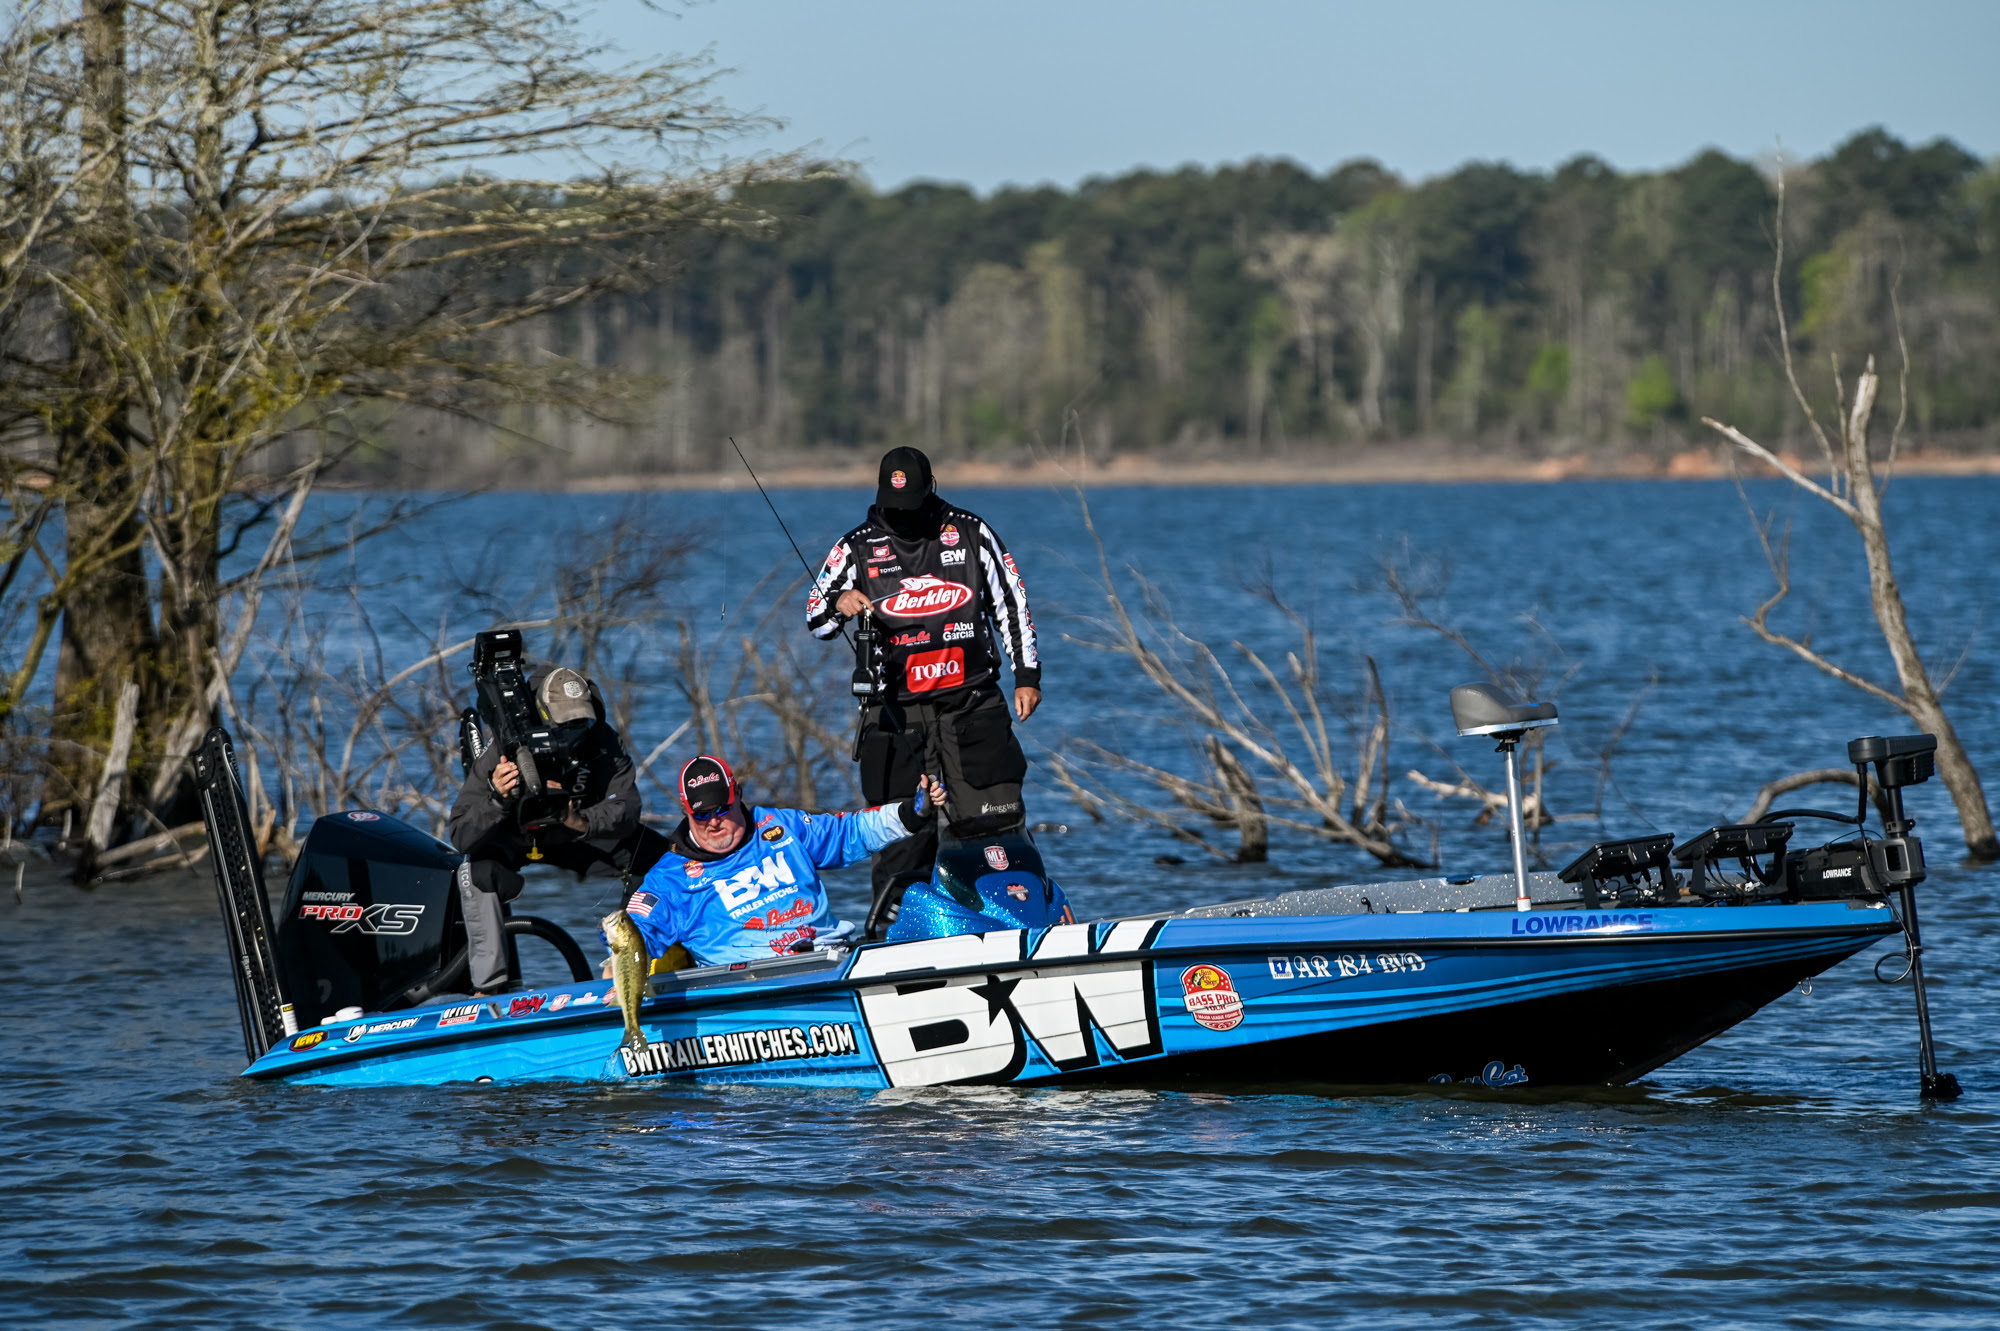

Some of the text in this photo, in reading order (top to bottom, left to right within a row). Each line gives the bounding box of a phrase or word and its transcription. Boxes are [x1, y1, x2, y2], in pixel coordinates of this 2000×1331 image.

[880, 565, 902, 574] TOYOTA
[893, 587, 961, 612] Berkley
[943, 630, 975, 641] Garcia
[953, 622, 974, 632] Abu
[911, 660, 959, 681] TORO
[987, 851, 1005, 862] MLF
[1822, 867, 1852, 879] LOWRANCE
[302, 891, 355, 901] MERCURY
[729, 885, 799, 919] TRAILER HITCHES
[767, 908, 796, 926] Bass
[794, 898, 813, 916] Cat
[1511, 914, 1653, 935] LOWRANCE
[770, 931, 799, 955] Strike
[1276, 962, 1283, 972] 1
[1294, 952, 1425, 978] AR 184 BVD
[1189, 993, 1237, 1007] BASS PRO
[442, 1003, 481, 1020] OPTIMA
[367, 1017, 420, 1034] MERCURY
[620, 1022, 858, 1077] BWTRAILERHITCHES.COM
[1482, 1060, 1529, 1087] Cat
